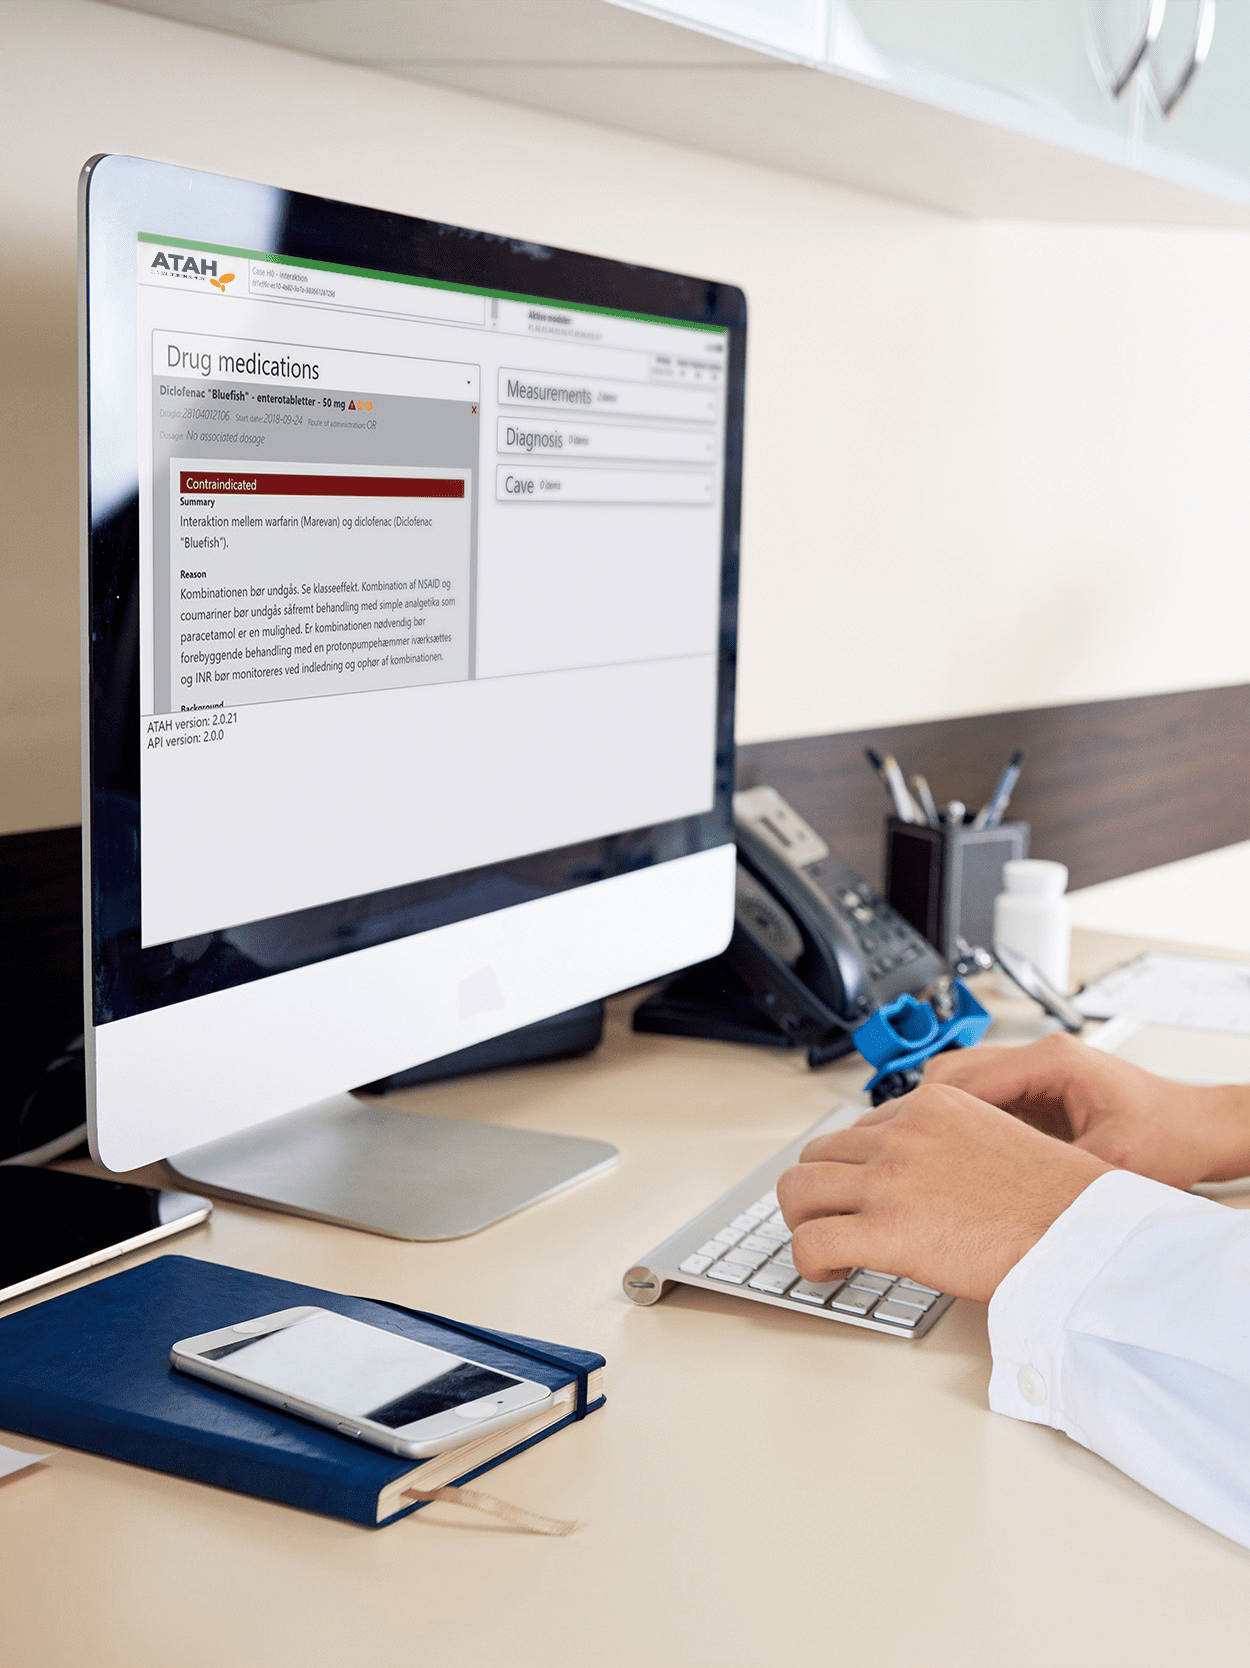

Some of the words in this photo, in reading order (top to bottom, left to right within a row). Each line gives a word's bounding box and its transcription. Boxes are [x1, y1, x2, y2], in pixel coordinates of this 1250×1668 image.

[151, 252, 217, 277] ATAH
[252, 267, 265, 276] Case
[280, 271, 308, 282] Interaktion
[528, 311, 547, 321] Aktive
[167, 345, 212, 376] Drug
[218, 353, 320, 380] medications
[160, 385, 205, 399] Diclofenac
[208, 388, 249, 401] "Bluefish"
[257, 394, 316, 407] enterotabletter
[323, 397, 332, 408] 50
[334, 401, 346, 411] mg
[507, 379, 592, 404] Measurements
[602, 393, 617, 402] items
[182, 408, 230, 421] 28104012106
[236, 414, 249, 423] Start
[263, 413, 303, 426] 2018-09-24
[308, 418, 322, 427] Route
[324, 419, 330, 427] of
[366, 420, 377, 430] OR
[160, 431, 183, 442] Dosage:
[186, 430, 198, 441] No
[200, 432, 238, 442] associated
[239, 433, 265, 447] dosage
[507, 427, 563, 452] Diagnosis
[574, 436, 589, 445] items
[186, 477, 257, 490] Contraindicated
[505, 475, 534, 494] Cave
[540, 480, 545, 490] 0
[545, 480, 561, 490] items
[180, 496, 215, 508] Summary
[180, 515, 229, 527] Interaktion
[231, 515, 263, 527] mellem
[265, 515, 299, 527] warfarin
[301, 516, 340, 529] (Marevan)
[342, 518, 353, 530] og
[354, 516, 392, 527] diclofenac
[393, 516, 433, 528] (Diclofenac
[180, 536, 229, 550] "Bluefish").
[180, 570, 207, 579] Reason
[180, 587, 247, 600] Kombinationen
[250, 585, 265, 597] bør
[267, 583, 299, 598] undgås.
[301, 583, 311, 594] Se
[313, 582, 359, 594] klasseeffekt.
[361, 580, 407, 592] Kombination
[409, 579, 416, 590] af
[417, 578, 441, 589] NSAID
[442, 580, 451, 591] og
[180, 608, 231, 621] coumariner
[234, 606, 249, 618] bør
[250, 603, 281, 619] undgås
[284, 603, 314, 615] såfremt
[316, 601, 359, 614] behandling
[361, 600, 378, 611] med
[379, 599, 403, 612] simple
[404, 597, 440, 610] analgetika
[441, 598, 456, 606] som
[180, 627, 235, 646] paracetamol
[238, 630, 247, 639] er
[249, 628, 260, 638] en
[262, 623, 302, 639] mulighed.
[305, 623, 313, 634] Er
[314, 620, 372, 633] kombinationen
[373, 618, 412, 630] nødvendig
[413, 616, 426, 626] bør
[180, 648, 243, 665] forebyggende
[245, 645, 292, 658] behandling
[294, 642, 312, 654] med
[314, 643, 324, 653] en
[326, 637, 410, 655] protonpumpehæmmer
[411, 633, 452, 645] iværksættes
[180, 675, 193, 688] og
[195, 671, 212, 683] INR
[214, 670, 230, 682] bør
[232, 667, 283, 680] monitoreres
[285, 663, 300, 675] ved
[302, 659, 343, 674] indledning
[345, 660, 355, 672] og
[357, 657, 380, 671] ophør
[381, 655, 389, 666] af
[390, 652, 444, 665] kombinationen.
[147, 719, 173, 733] ATAH
[175, 716, 210, 730] version:
[213, 712, 237, 726] 2.0.21
[147, 736, 163, 750] API
[165, 733, 201, 747] version:
[203, 729, 224, 743] 2.0.0
